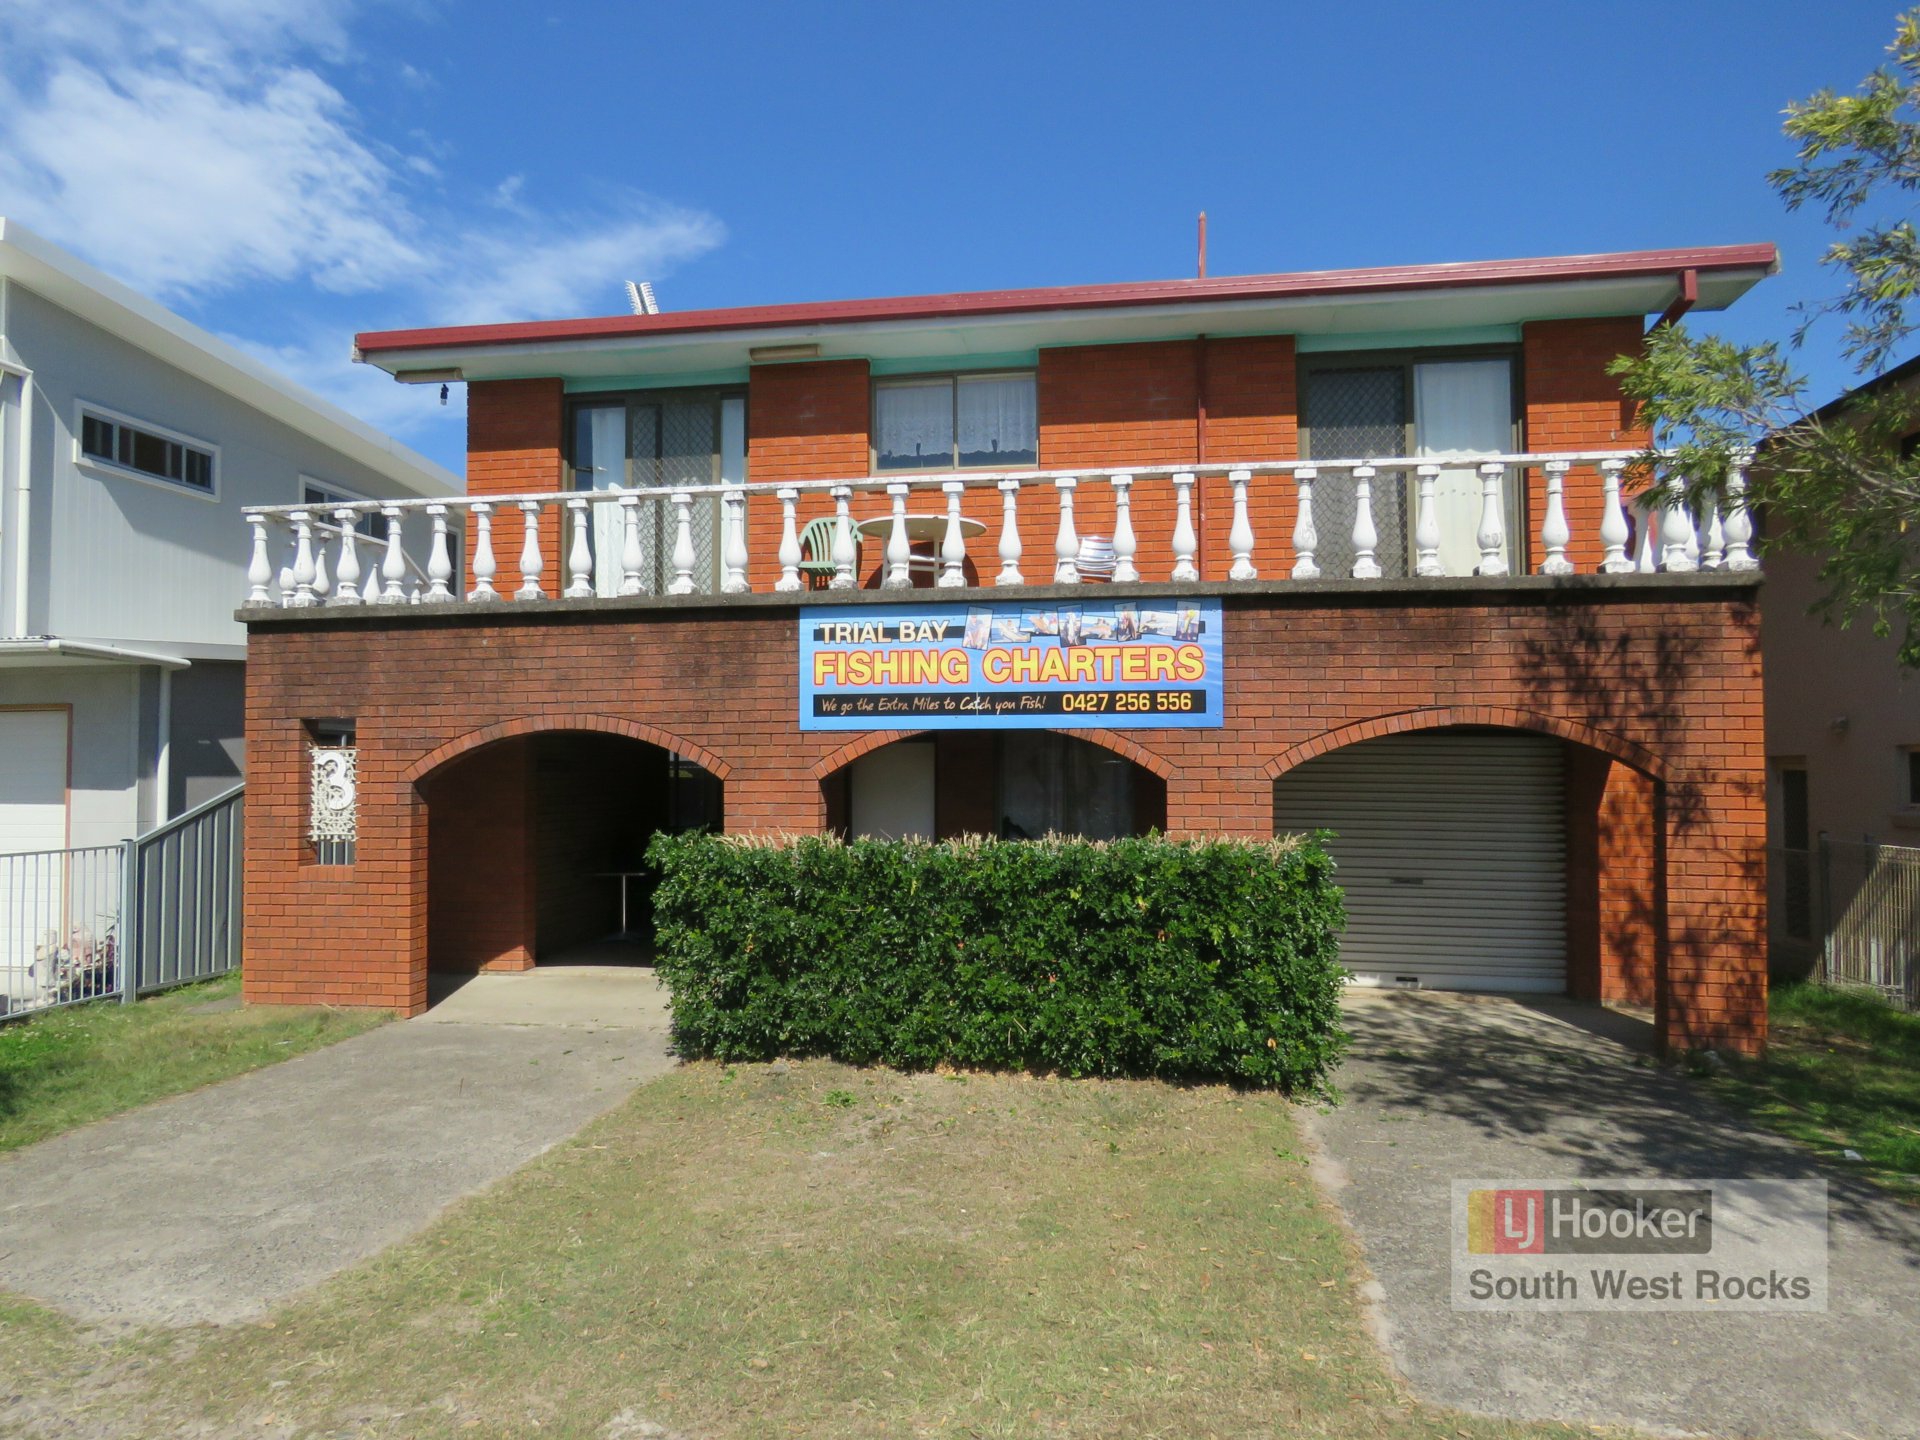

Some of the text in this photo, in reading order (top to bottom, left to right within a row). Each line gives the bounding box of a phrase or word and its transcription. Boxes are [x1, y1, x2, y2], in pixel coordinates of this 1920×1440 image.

[819, 620, 949, 644] TRIAL BAY
[813, 645, 1205, 686] FISHING CHARTERS
[822, 692, 1192, 715] We go the Extra Miles to Catch you Fish! 0427 256 556
[317, 751, 354, 811] 3
